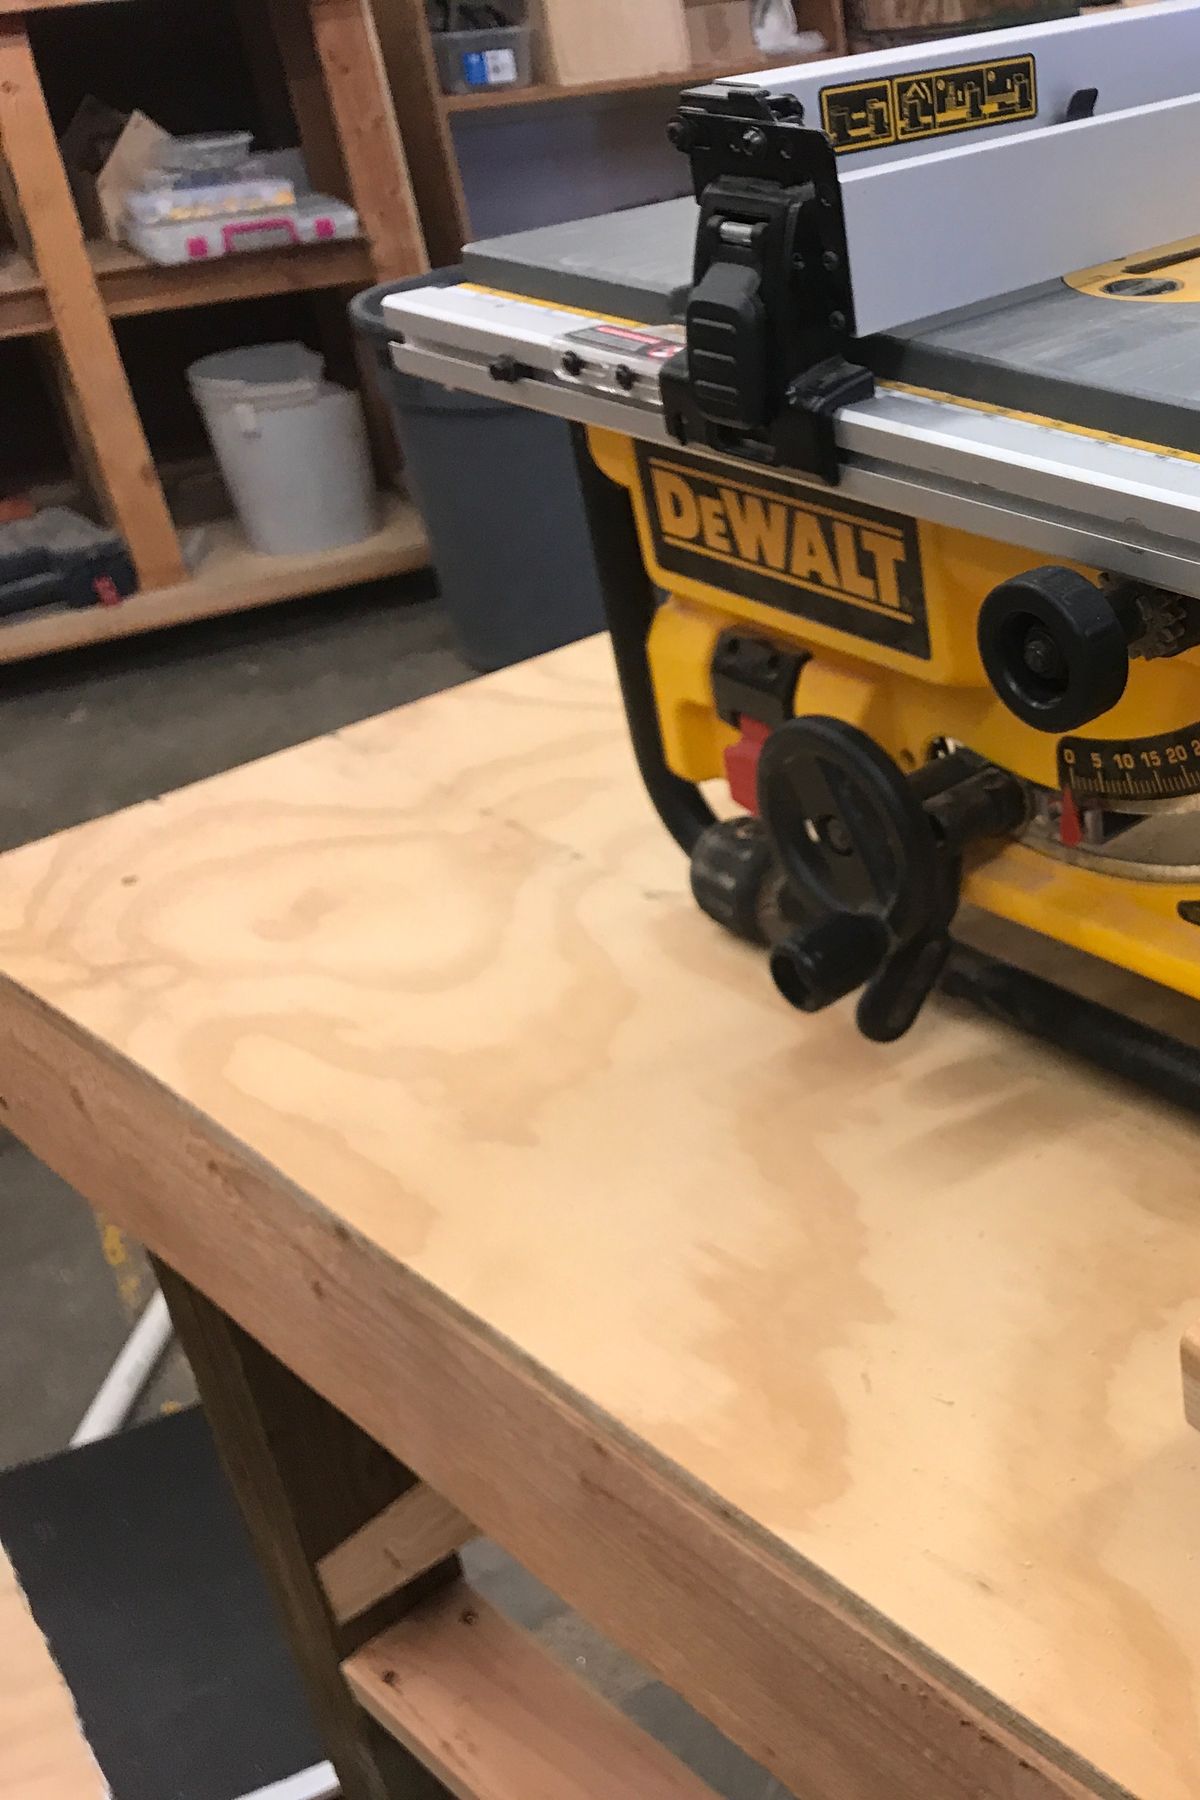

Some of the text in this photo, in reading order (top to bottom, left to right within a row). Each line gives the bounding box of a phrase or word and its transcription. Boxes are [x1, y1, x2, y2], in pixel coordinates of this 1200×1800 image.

[1064, 749, 1075, 764] 0
[1090, 752, 1102, 768] 5
[1113, 753, 1135, 769] 10
[1141, 751, 1161, 767] 15
[1165, 744, 1188, 765] 20
